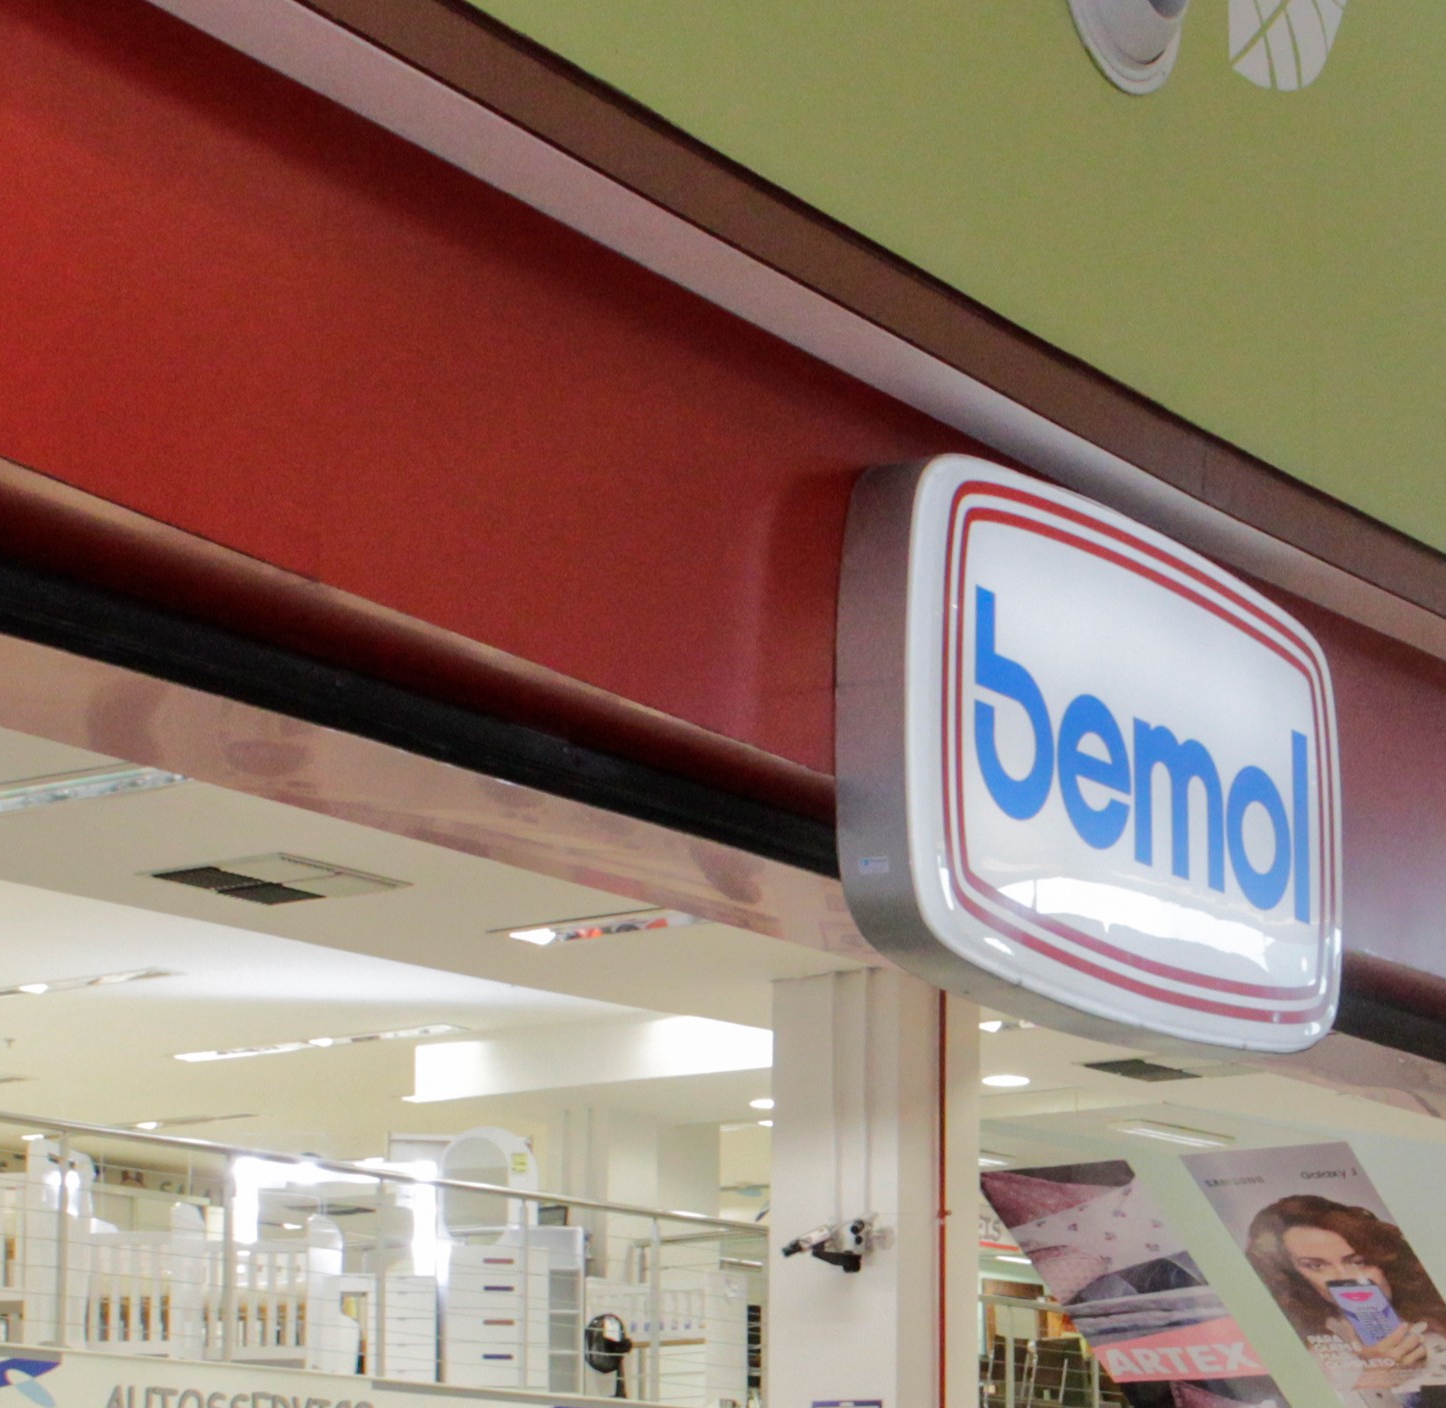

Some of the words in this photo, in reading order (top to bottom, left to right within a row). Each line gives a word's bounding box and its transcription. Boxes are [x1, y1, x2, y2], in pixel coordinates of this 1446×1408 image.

[974, 585, 1310, 926] bemol
[1300, 1169, 1347, 1180] Galaxy
[1105, 1342, 1263, 1377] ARTEX
